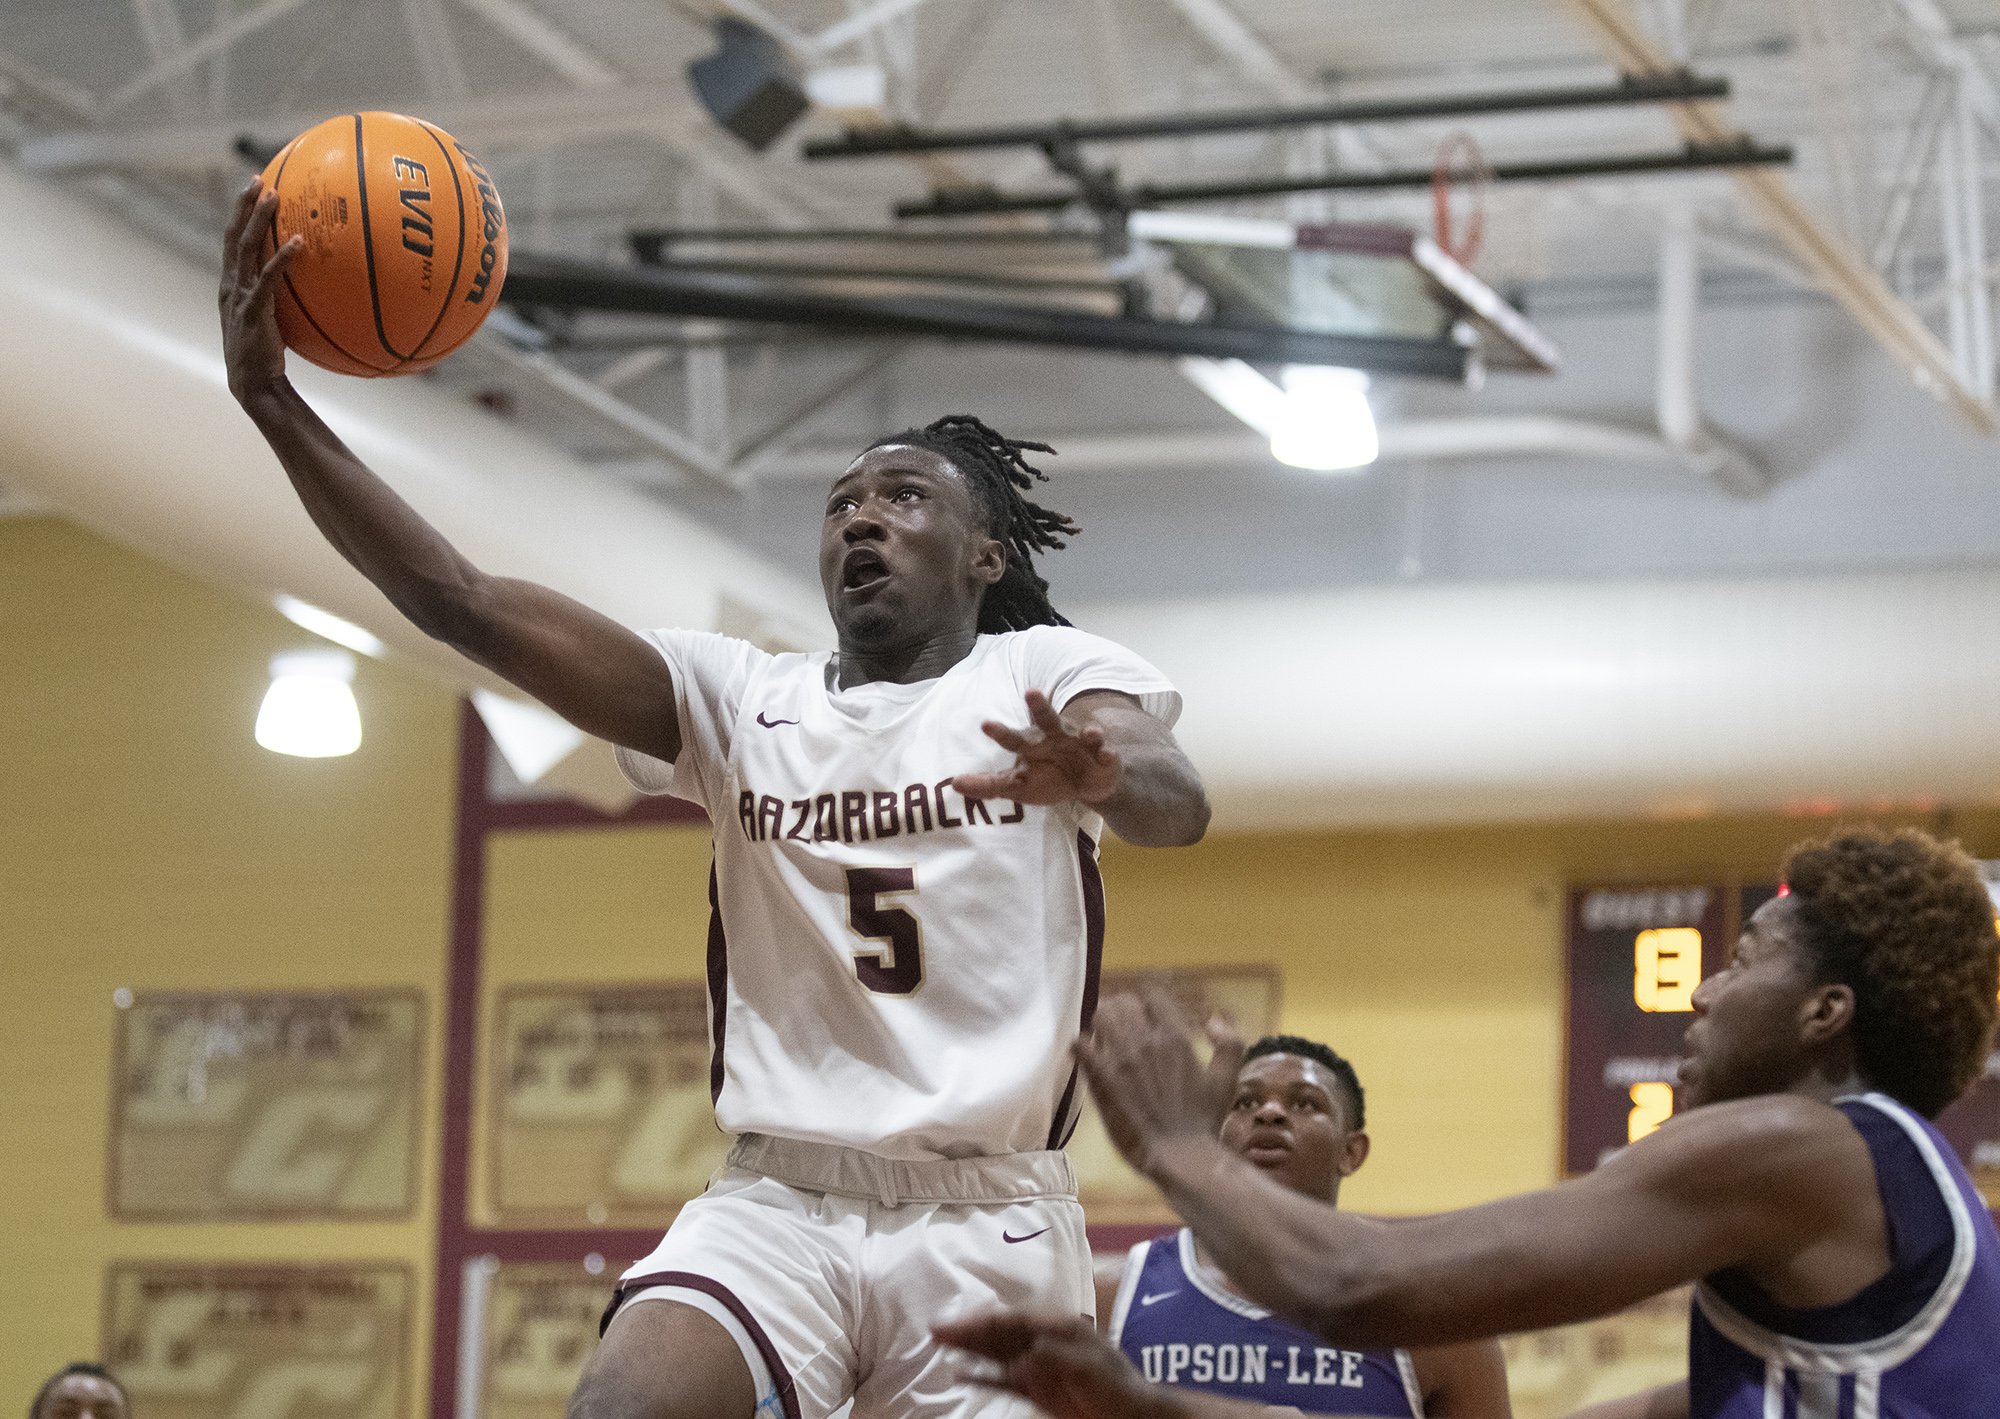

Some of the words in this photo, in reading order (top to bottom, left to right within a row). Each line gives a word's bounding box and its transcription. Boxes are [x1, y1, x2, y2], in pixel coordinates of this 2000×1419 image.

[392, 155, 433, 258] EVO
[421, 258, 433, 291] NXT
[846, 864, 925, 996] 5
[1634, 927, 1702, 1012] 8
[1142, 1344, 1363, 1387] UPSON-LEE
